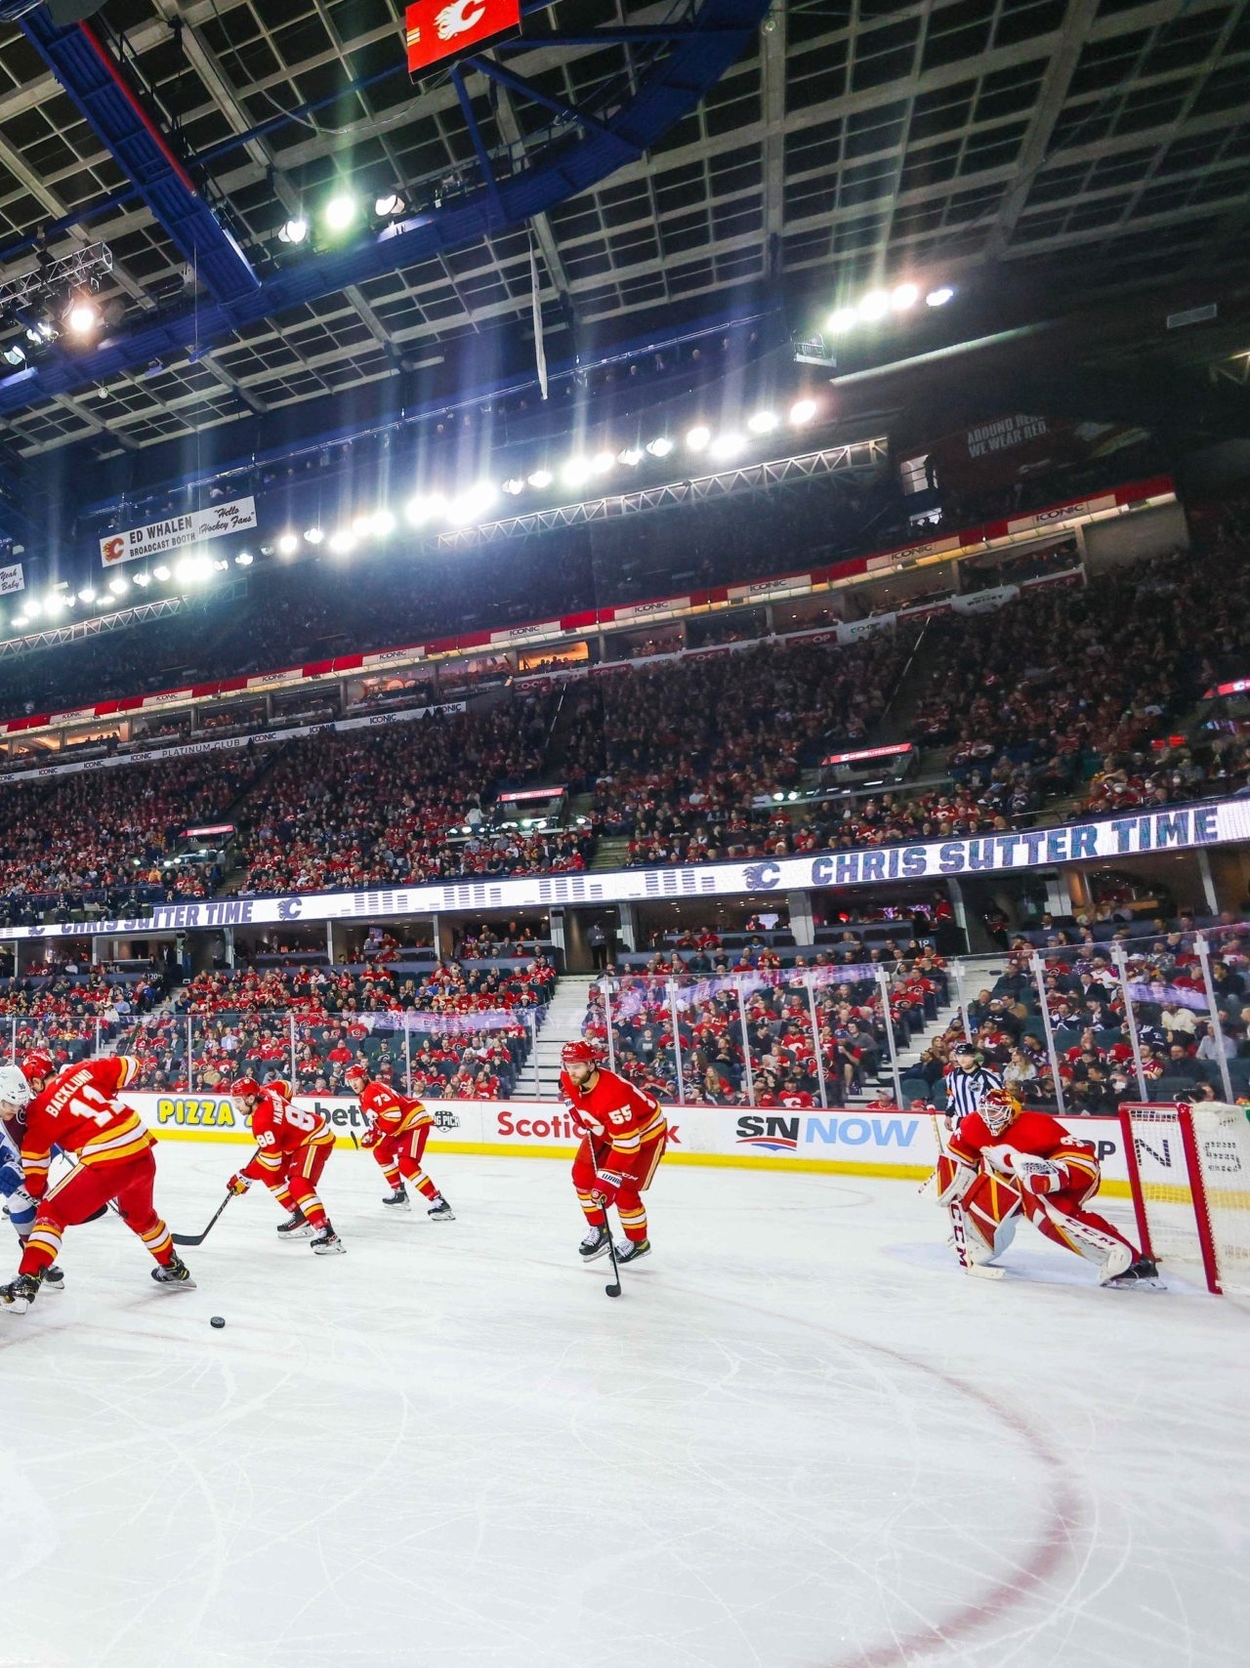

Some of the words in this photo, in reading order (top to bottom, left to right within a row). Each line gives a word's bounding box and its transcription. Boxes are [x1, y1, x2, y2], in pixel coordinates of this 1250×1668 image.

[1035, 503, 1084, 523] ICONIC
[130, 530, 144, 545] ED
[146, 515, 193, 539] WHALEN
[130, 540, 170, 557] BROADCAST
[172, 532, 196, 546] BOOTH
[509, 625, 540, 636] ICONIC
[369, 713, 397, 725] ICONIC
[130, 752, 152, 762] ICONIC
[162, 743, 211, 758] PLATINUM
[214, 738, 240, 749] CLUB
[38, 766, 59, 776] ICONIC
[811, 847, 928, 886] CHRIS
[938, 824, 1098, 873] SUTTER
[1111, 806, 1218, 852] TIME
[205, 901, 254, 925] TIME
[45, 1068, 94, 1119] BACKLUND
[68, 1083, 128, 1128] 11
[373, 1094, 392, 1107] 73
[157, 1098, 236, 1127] PIZZA
[608, 1104, 633, 1126] 55
[736, 1115, 799, 1141] SN
[805, 1118, 920, 1147] NOW
[950, 1203, 970, 1268] CCM
[1065, 1217, 1117, 1247] CCM
